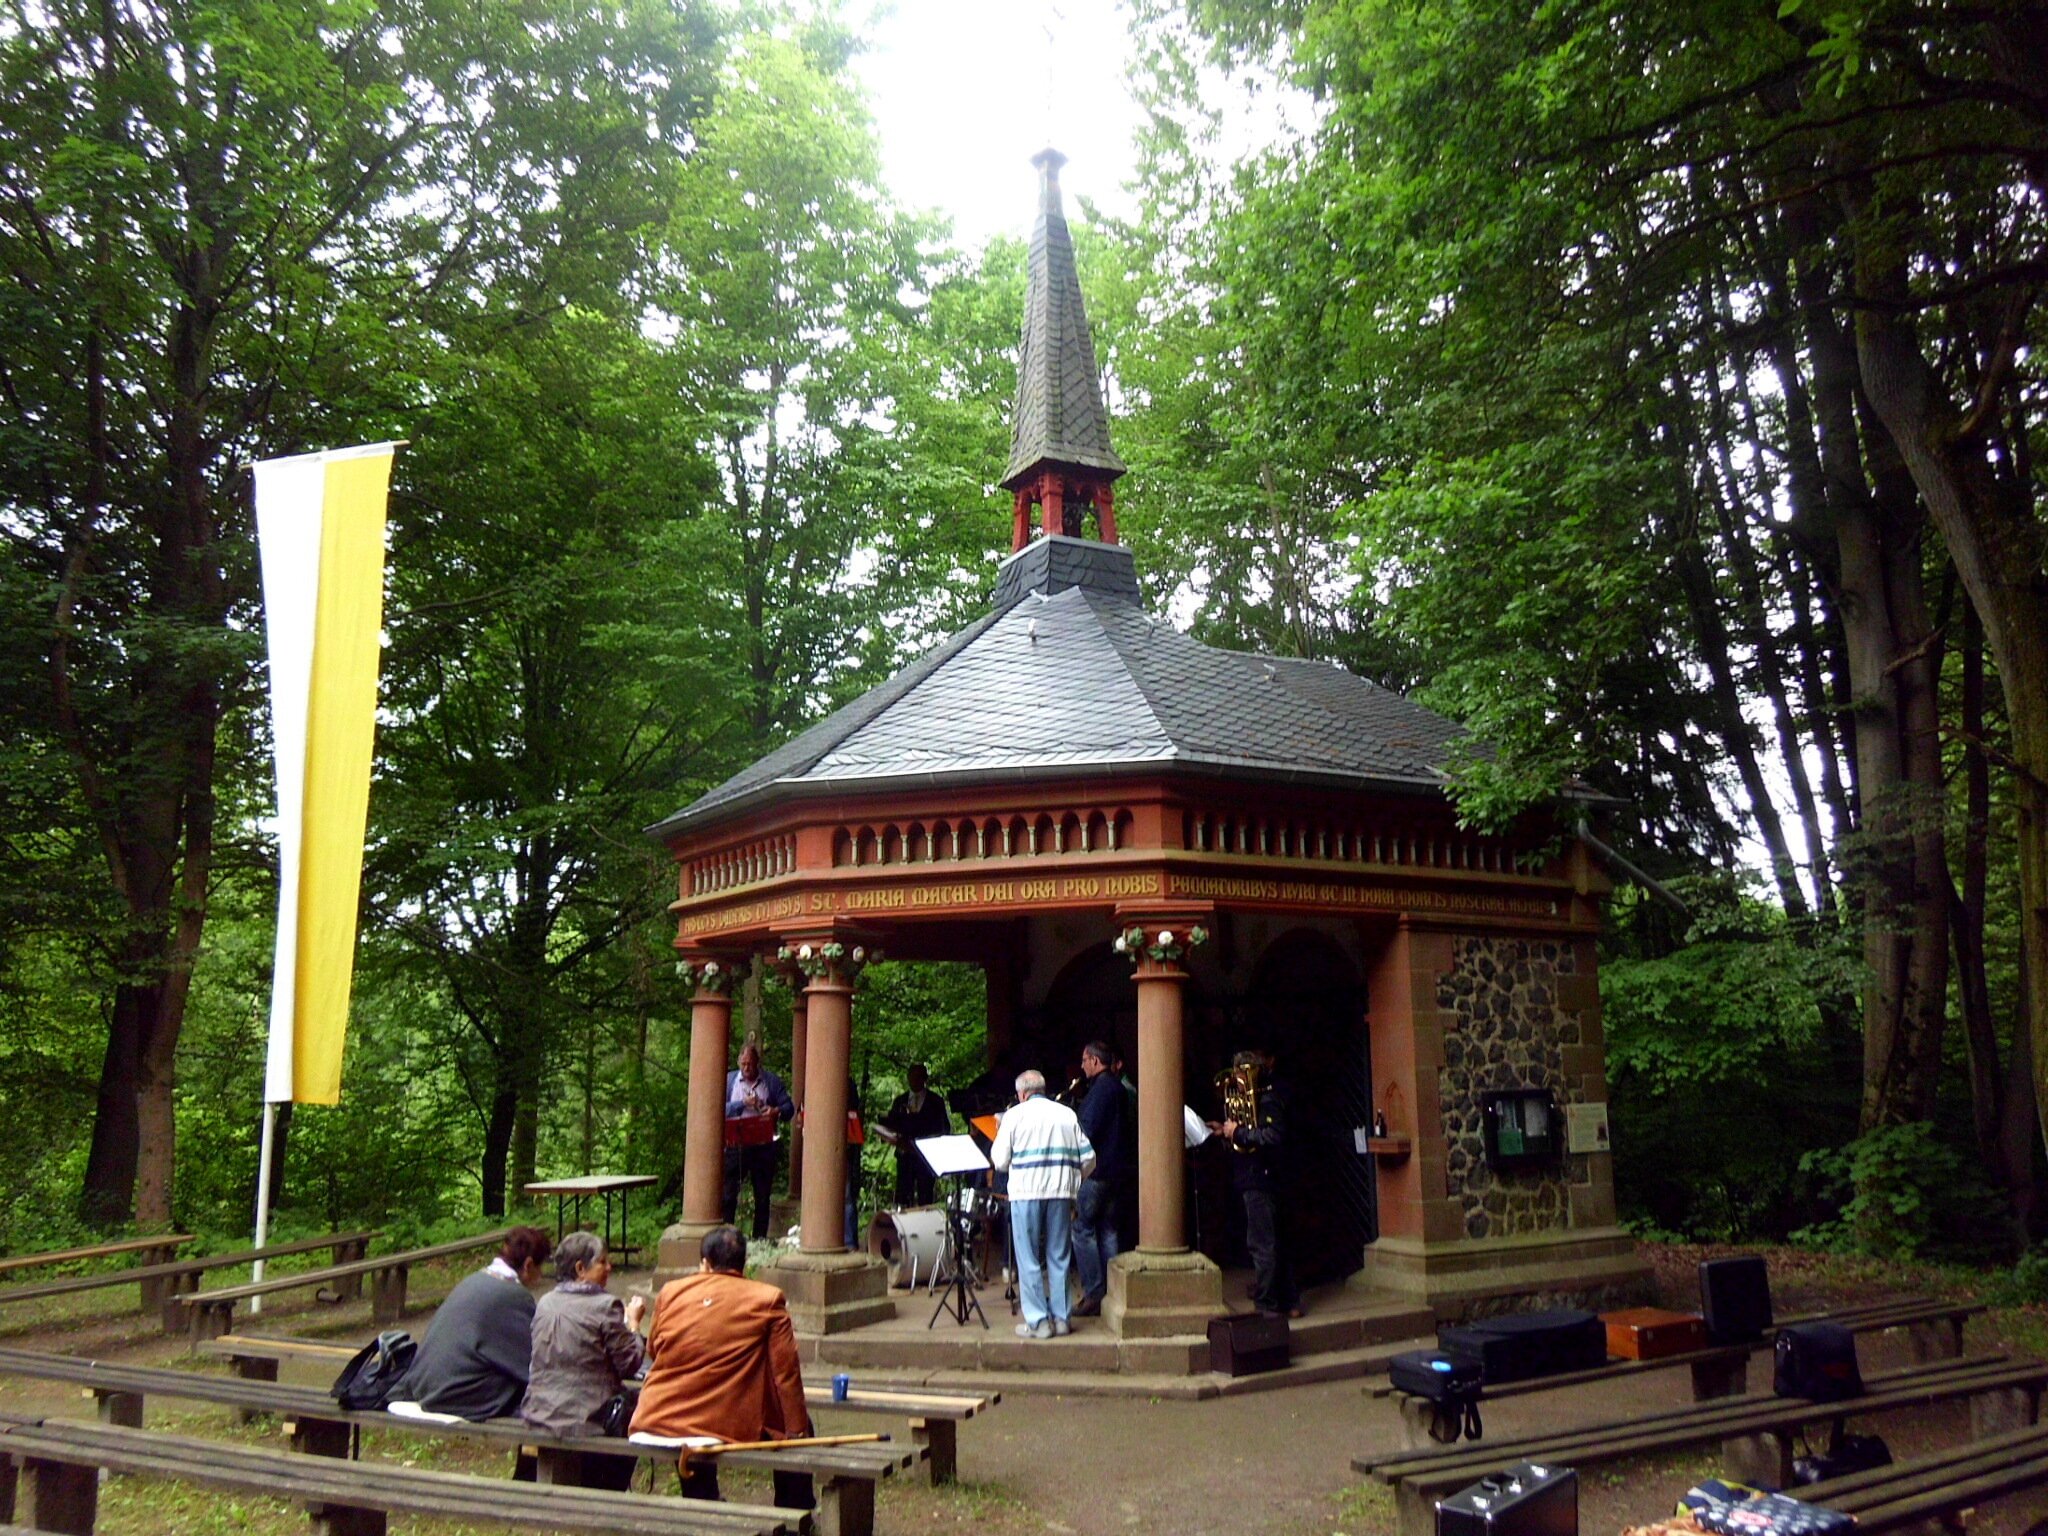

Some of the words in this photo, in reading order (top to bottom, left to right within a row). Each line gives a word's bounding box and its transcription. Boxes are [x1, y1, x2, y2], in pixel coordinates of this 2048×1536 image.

[845, 888, 906, 909] MARIA
[911, 883, 978, 906] MATER
[983, 882, 1015, 902] DEI
[1020, 879, 1057, 900] ORA
[1063, 878, 1099, 898] PRO
[1105, 874, 1159, 895] NOBIS
